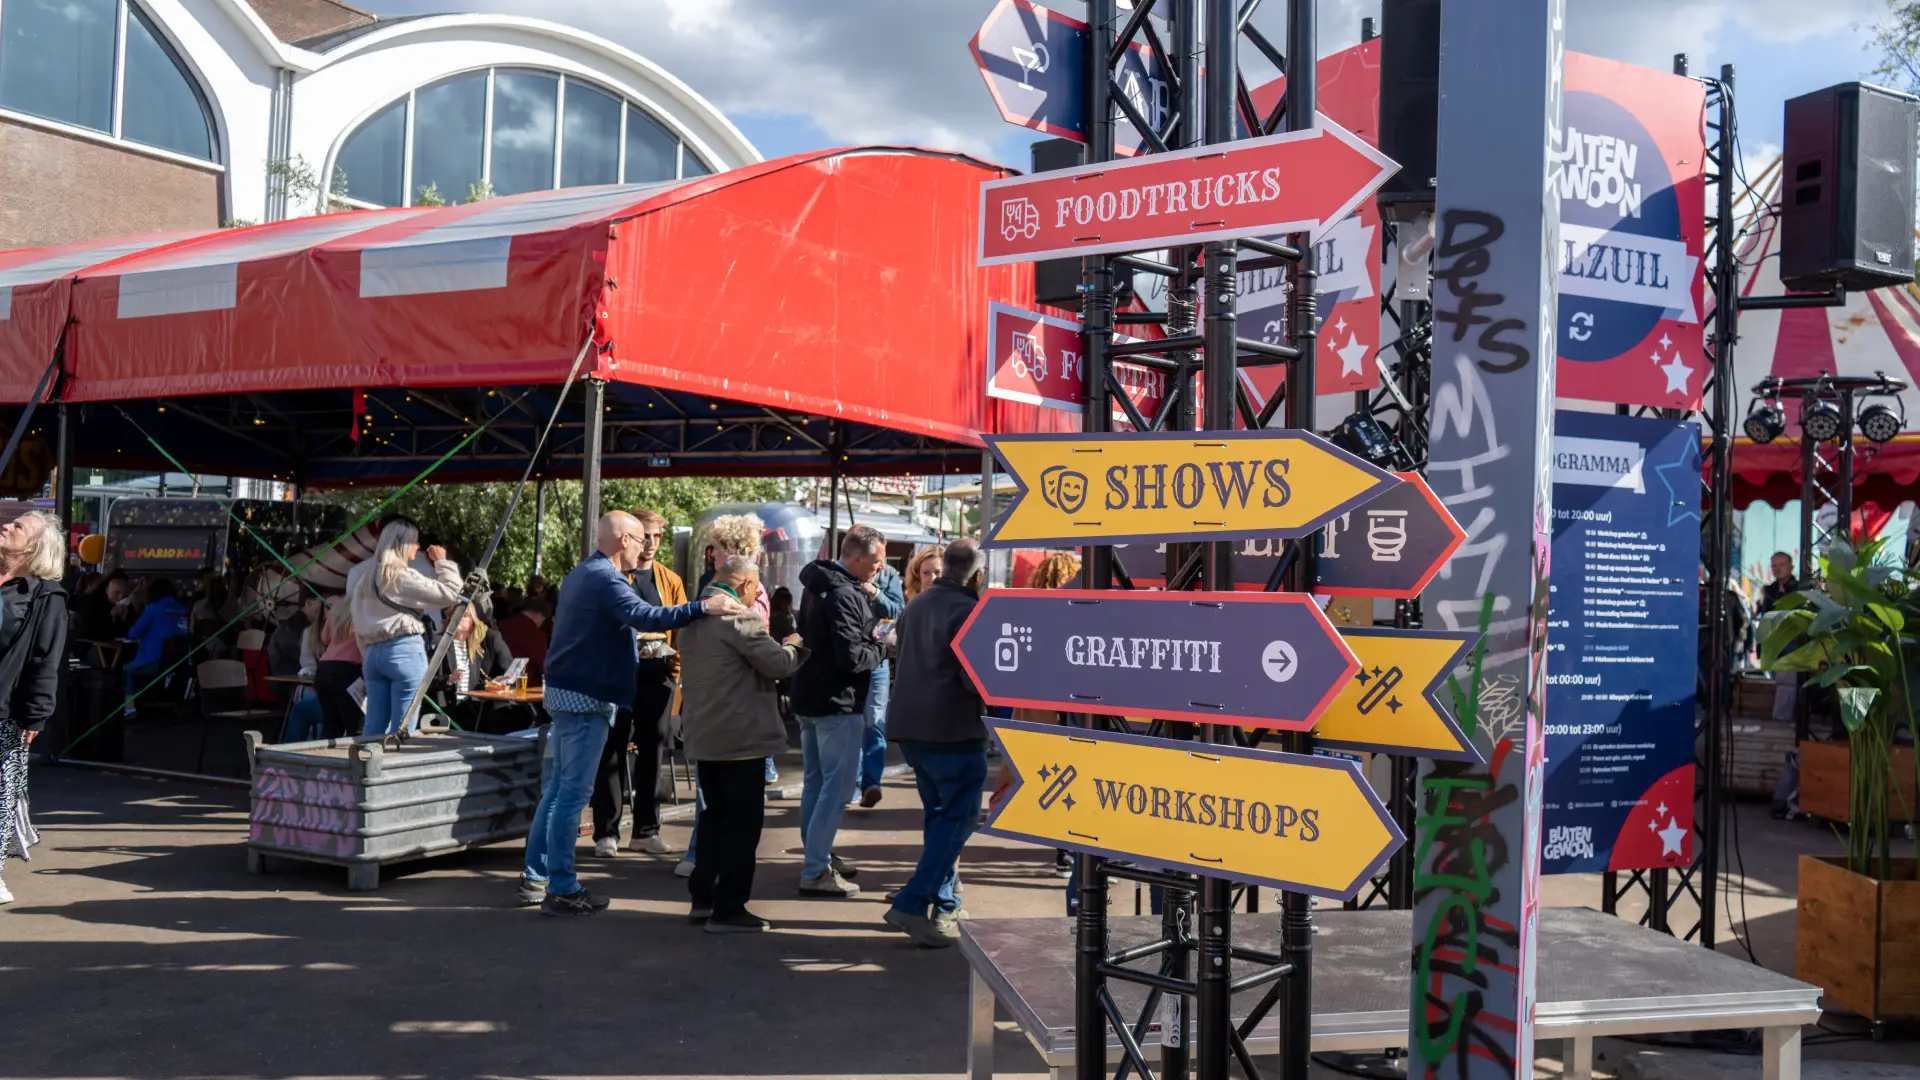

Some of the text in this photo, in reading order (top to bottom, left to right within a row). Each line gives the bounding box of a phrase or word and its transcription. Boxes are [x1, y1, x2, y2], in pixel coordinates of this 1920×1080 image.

[1561, 126, 1638, 182] UITEN
[1055, 167, 1281, 228] FOODTRUCKS
[1561, 166, 1641, 219] WOON
[1562, 239, 1669, 291] LZUIL
[1105, 458, 1292, 511] SHOWS
[1553, 452, 1632, 474] GRAMMA
[1557, 510, 1570, 520] tot
[1571, 510, 1594, 521] 20:00
[1595, 511, 1612, 524] uur)
[1065, 635, 1222, 673] GRAFFITI
[1559, 674, 1584, 685] 00:00
[1584, 673, 1602, 687] uur)
[1569, 724, 1582, 735] tot
[1582, 724, 1605, 735] 23:00
[1094, 777, 1320, 842] WORKSHOPS
[1549, 826, 1592, 844] BUITEN
